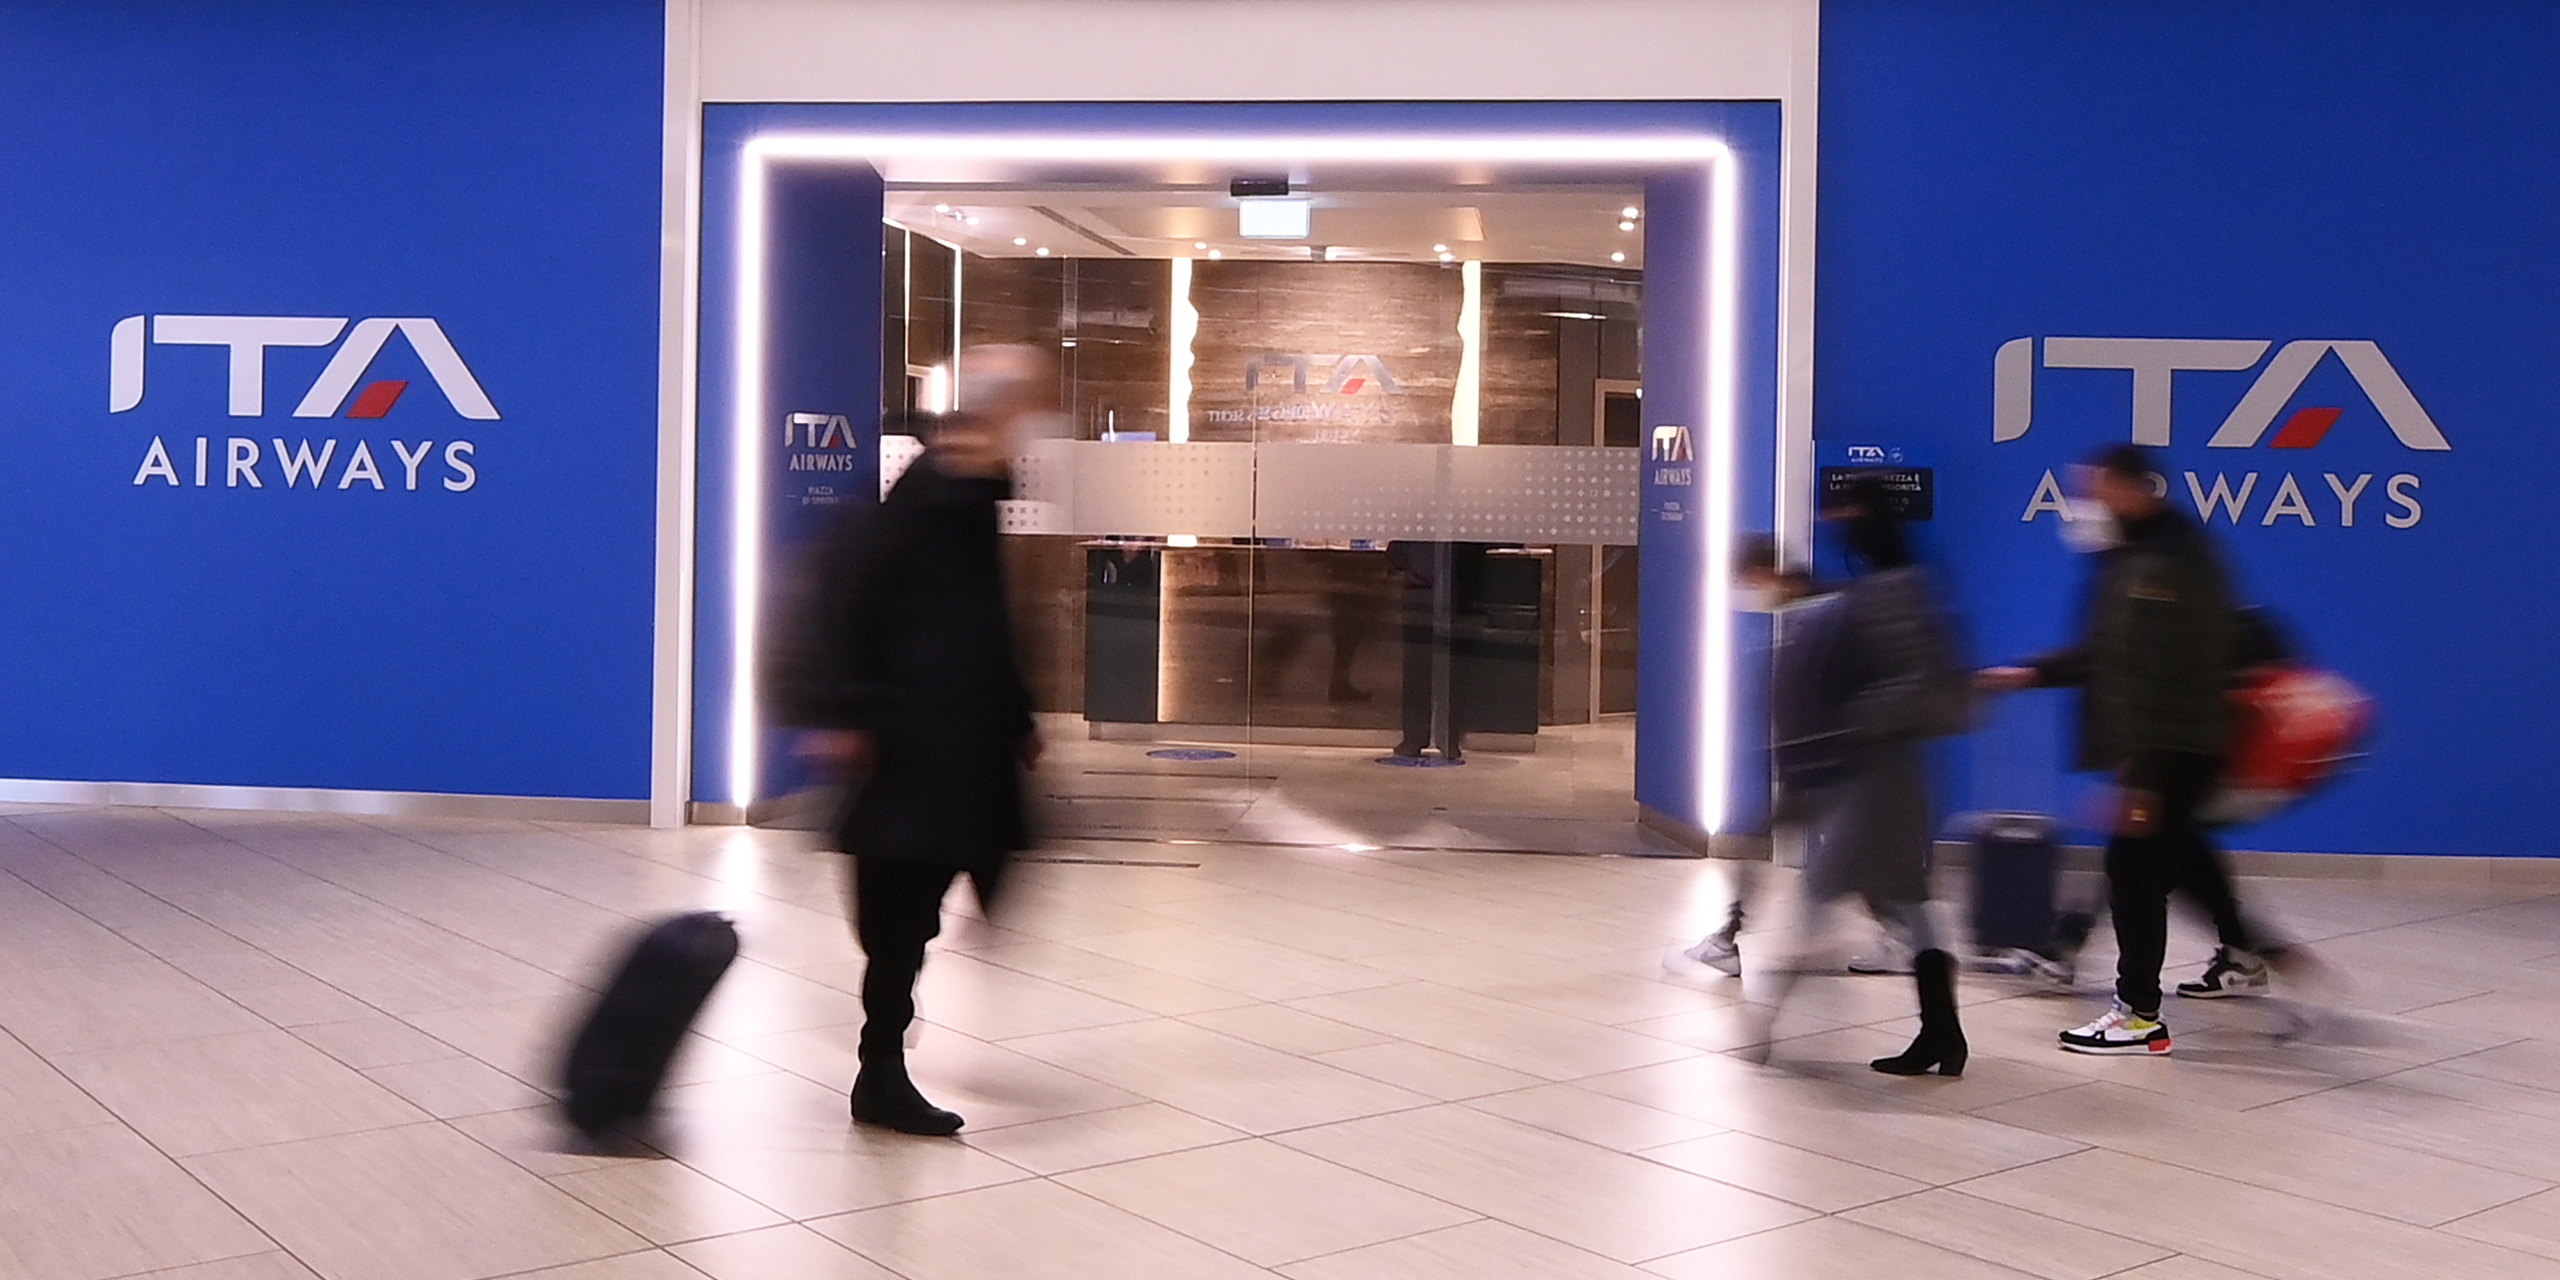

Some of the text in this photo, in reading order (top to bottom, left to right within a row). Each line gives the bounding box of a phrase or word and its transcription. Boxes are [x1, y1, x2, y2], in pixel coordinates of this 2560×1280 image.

[110, 315, 501, 420] ITA
[1246, 354, 1403, 394] ITA
[1993, 336, 2453, 450] ITA
[785, 413, 857, 448] ITA
[1652, 426, 1693, 462] ITA
[133, 435, 477, 491] AIRWAYS
[789, 454, 853, 471] AIRWAYS
[1848, 446, 1885, 457] ITA
[2021, 468, 2422, 528] AWAYS
